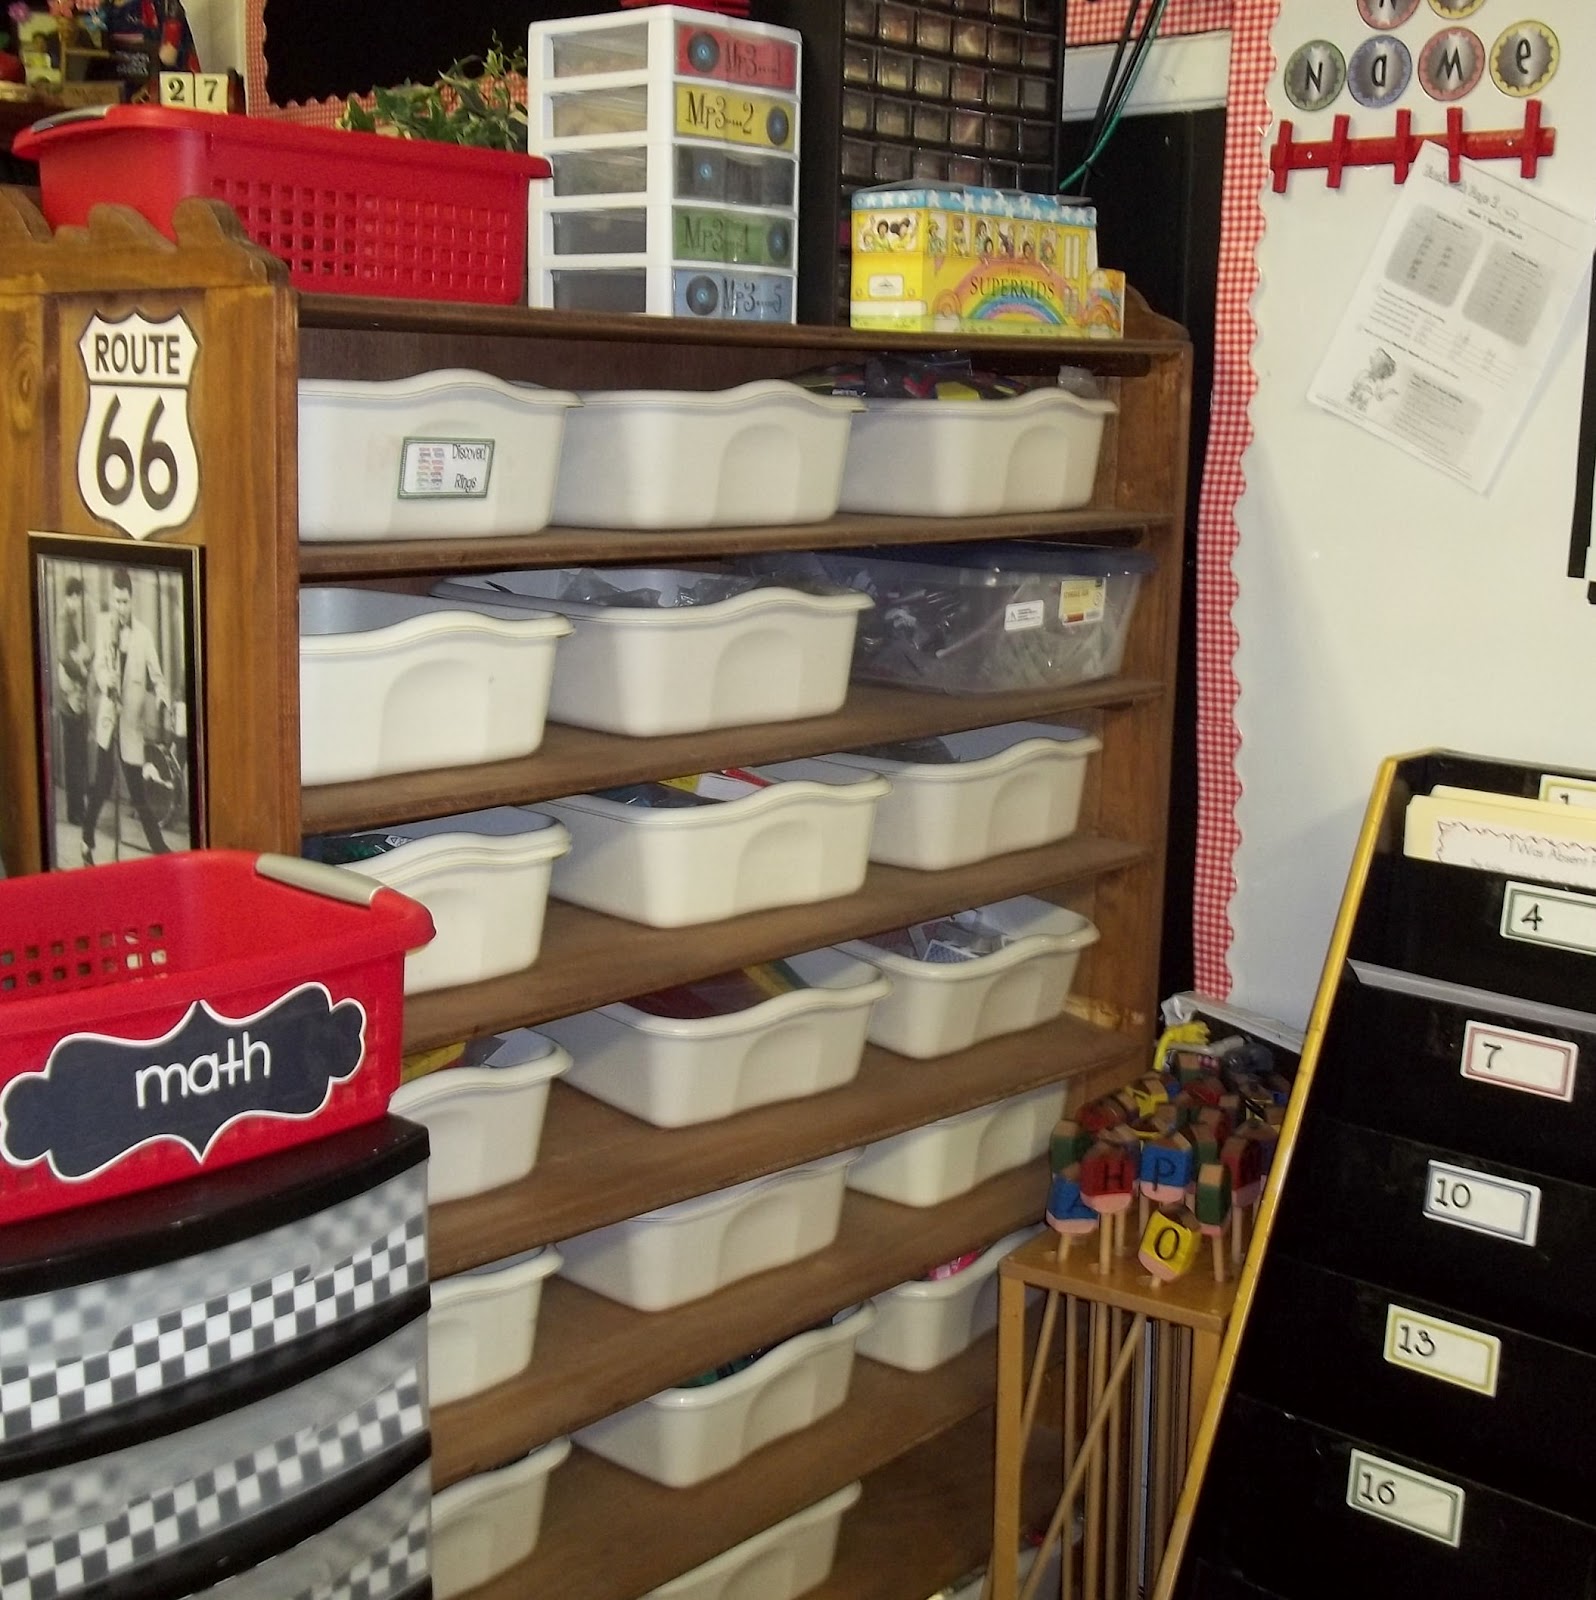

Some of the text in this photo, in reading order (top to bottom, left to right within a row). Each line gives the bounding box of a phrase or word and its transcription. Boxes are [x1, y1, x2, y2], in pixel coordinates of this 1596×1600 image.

[970, 276, 1055, 300] SUPERKIDS
[95, 333, 180, 375] ROUTE
[97, 394, 178, 511] 66
[454, 473, 477, 493] Rings
[1521, 902, 1543, 931] 4
[135, 1030, 271, 1110] math
[1483, 1041, 1503, 1069] 7
[1103, 1160, 1125, 1191] H
[1435, 1178, 1471, 1209] 10
[1398, 1323, 1437, 1357] 13
[1360, 1471, 1396, 1506] 16
